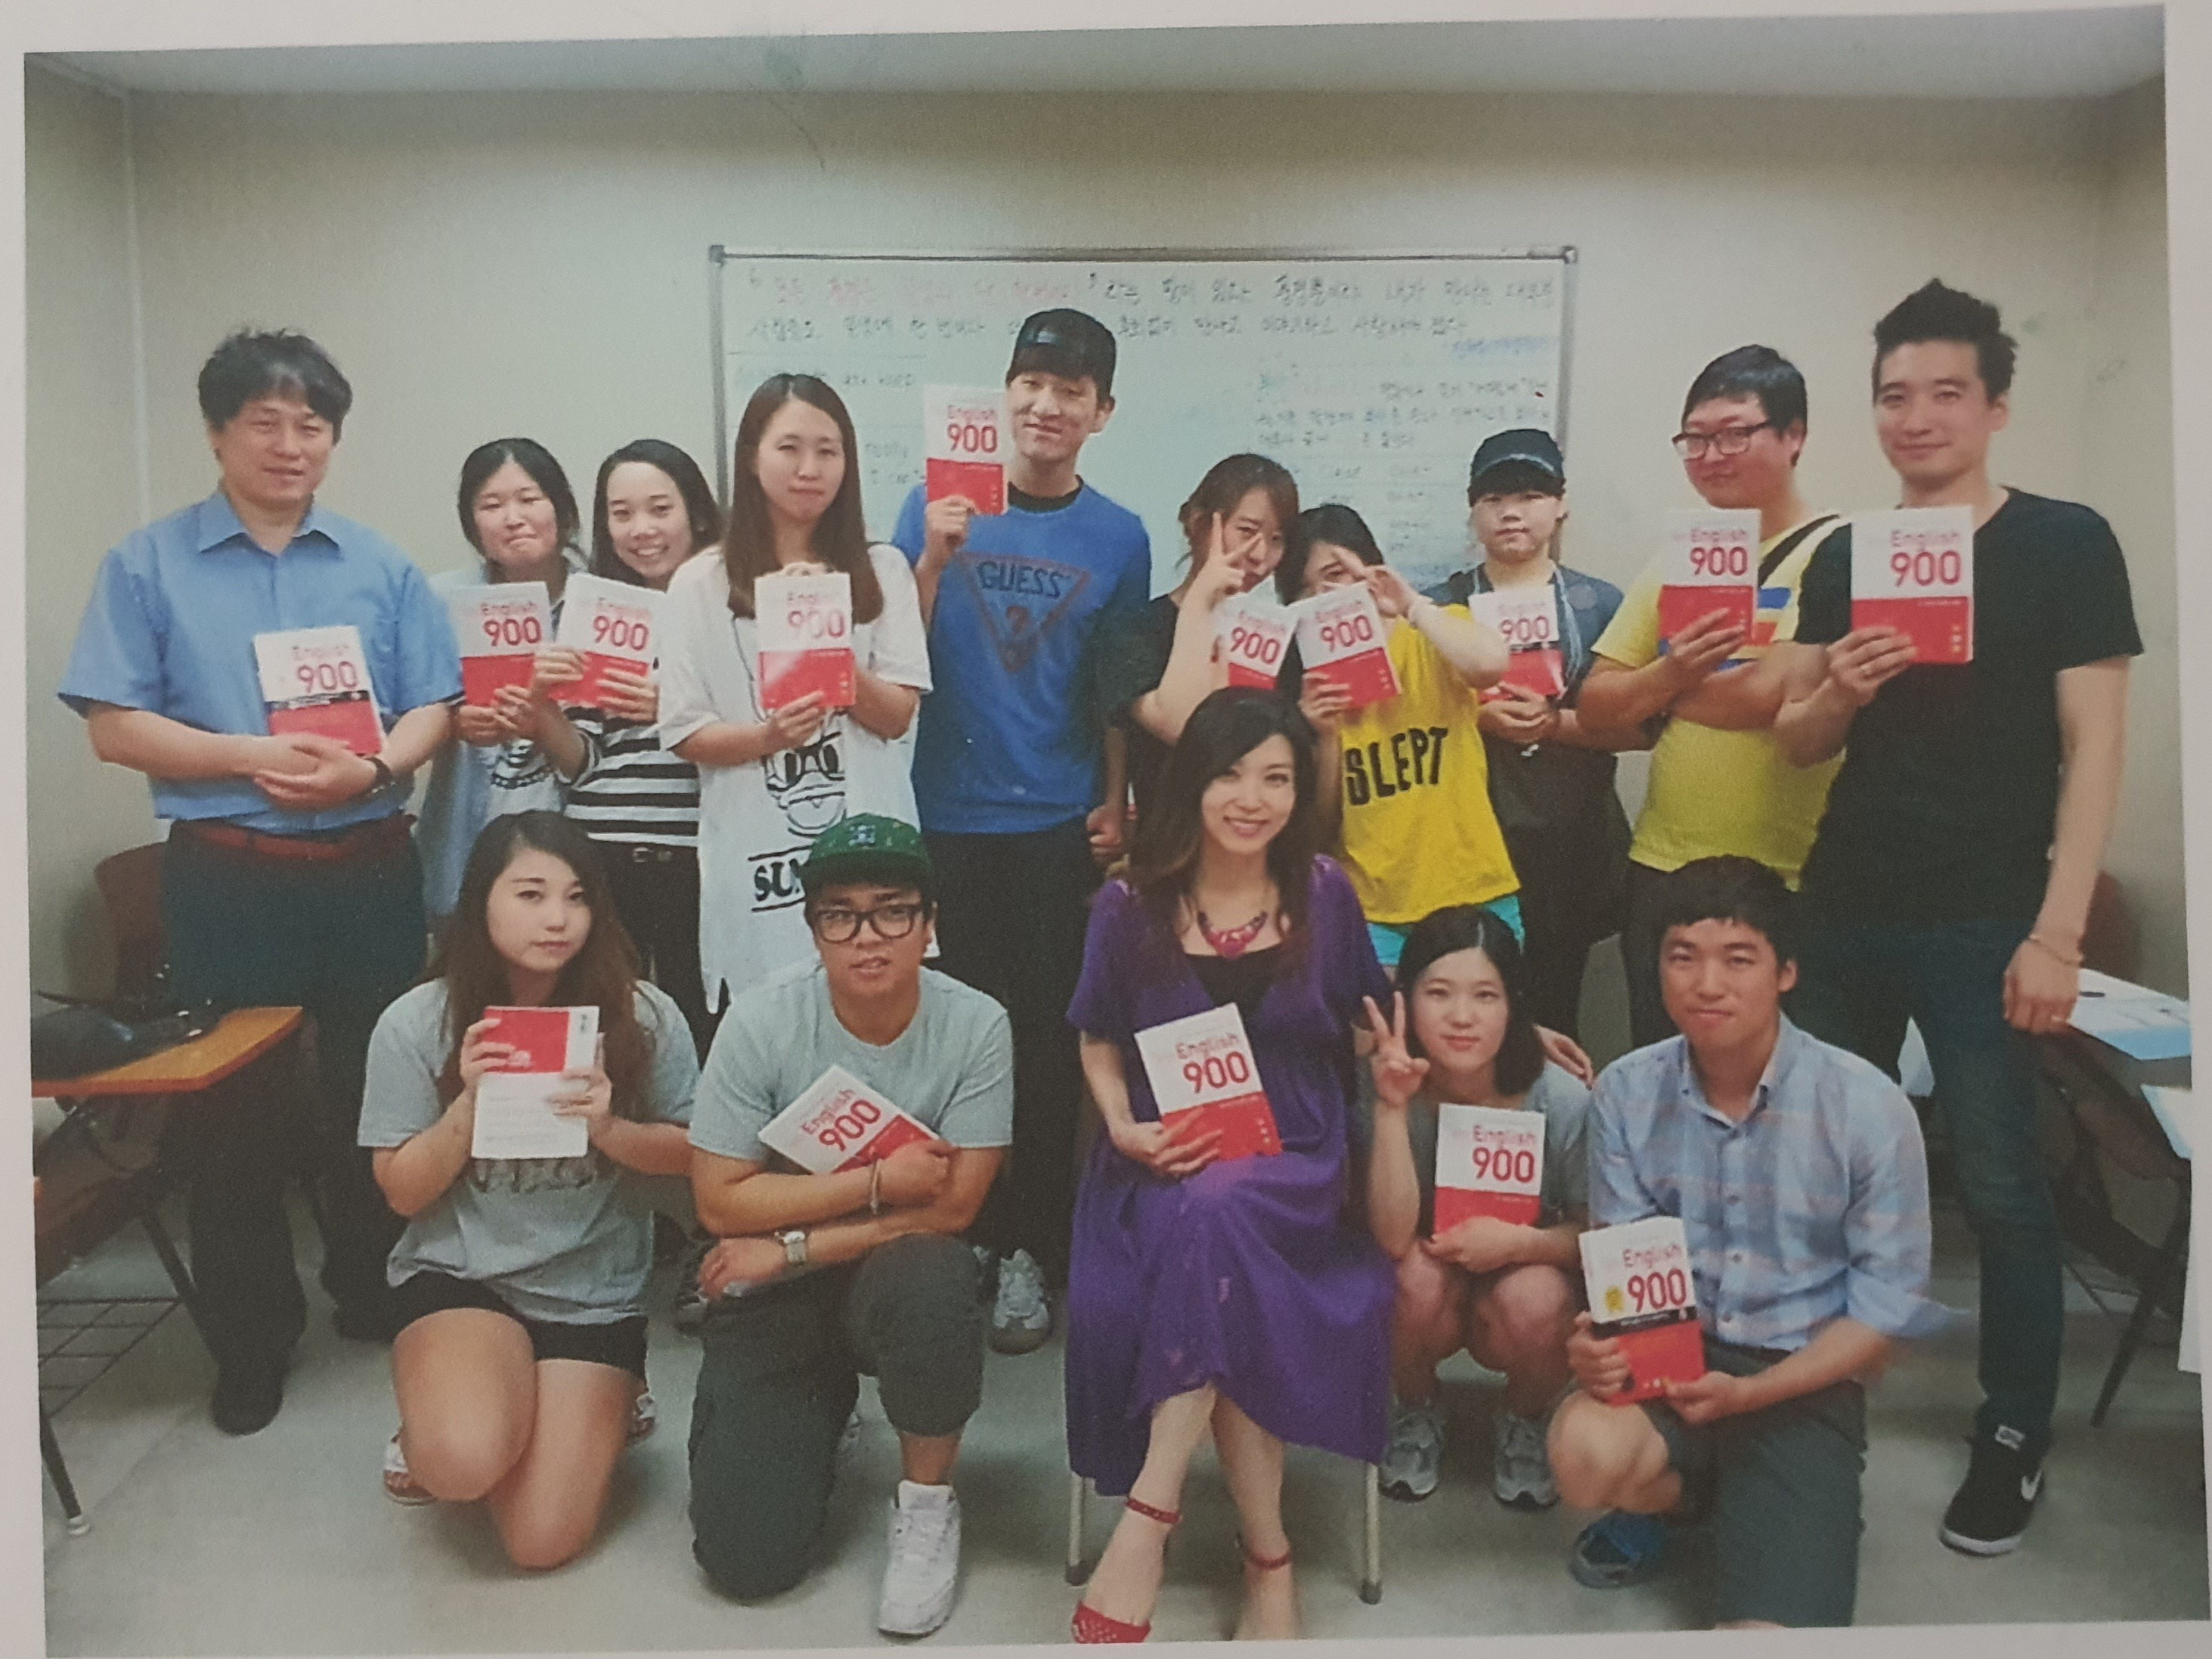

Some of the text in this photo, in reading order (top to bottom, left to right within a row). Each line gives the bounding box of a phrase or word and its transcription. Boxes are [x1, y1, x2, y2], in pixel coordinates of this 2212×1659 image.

[947, 423, 998, 454] 900
[1690, 527, 1749, 547] English
[1891, 529, 1960, 552] English
[1690, 545, 1748, 577] 900
[1891, 549, 1961, 588] 900
[977, 560, 1067, 599] GUESS
[483, 616, 542, 647] 900
[593, 615, 649, 651] 900
[788, 609, 846, 639] 900
[1320, 614, 1374, 653] 900
[1501, 615, 1550, 643] 900
[1230, 626, 1282, 665] 900
[296, 660, 358, 693] 900
[1344, 726, 1449, 806] SLEPT
[754, 857, 804, 902] SU
[1176, 1031, 1238, 1060] English
[1182, 1051, 1250, 1094] 900
[801, 1087, 857, 1136] English
[818, 1099, 881, 1152] 900
[1473, 1124, 1536, 1150] English
[1473, 1146, 1535, 1183] 900
[1627, 1267, 1687, 1313] 900
